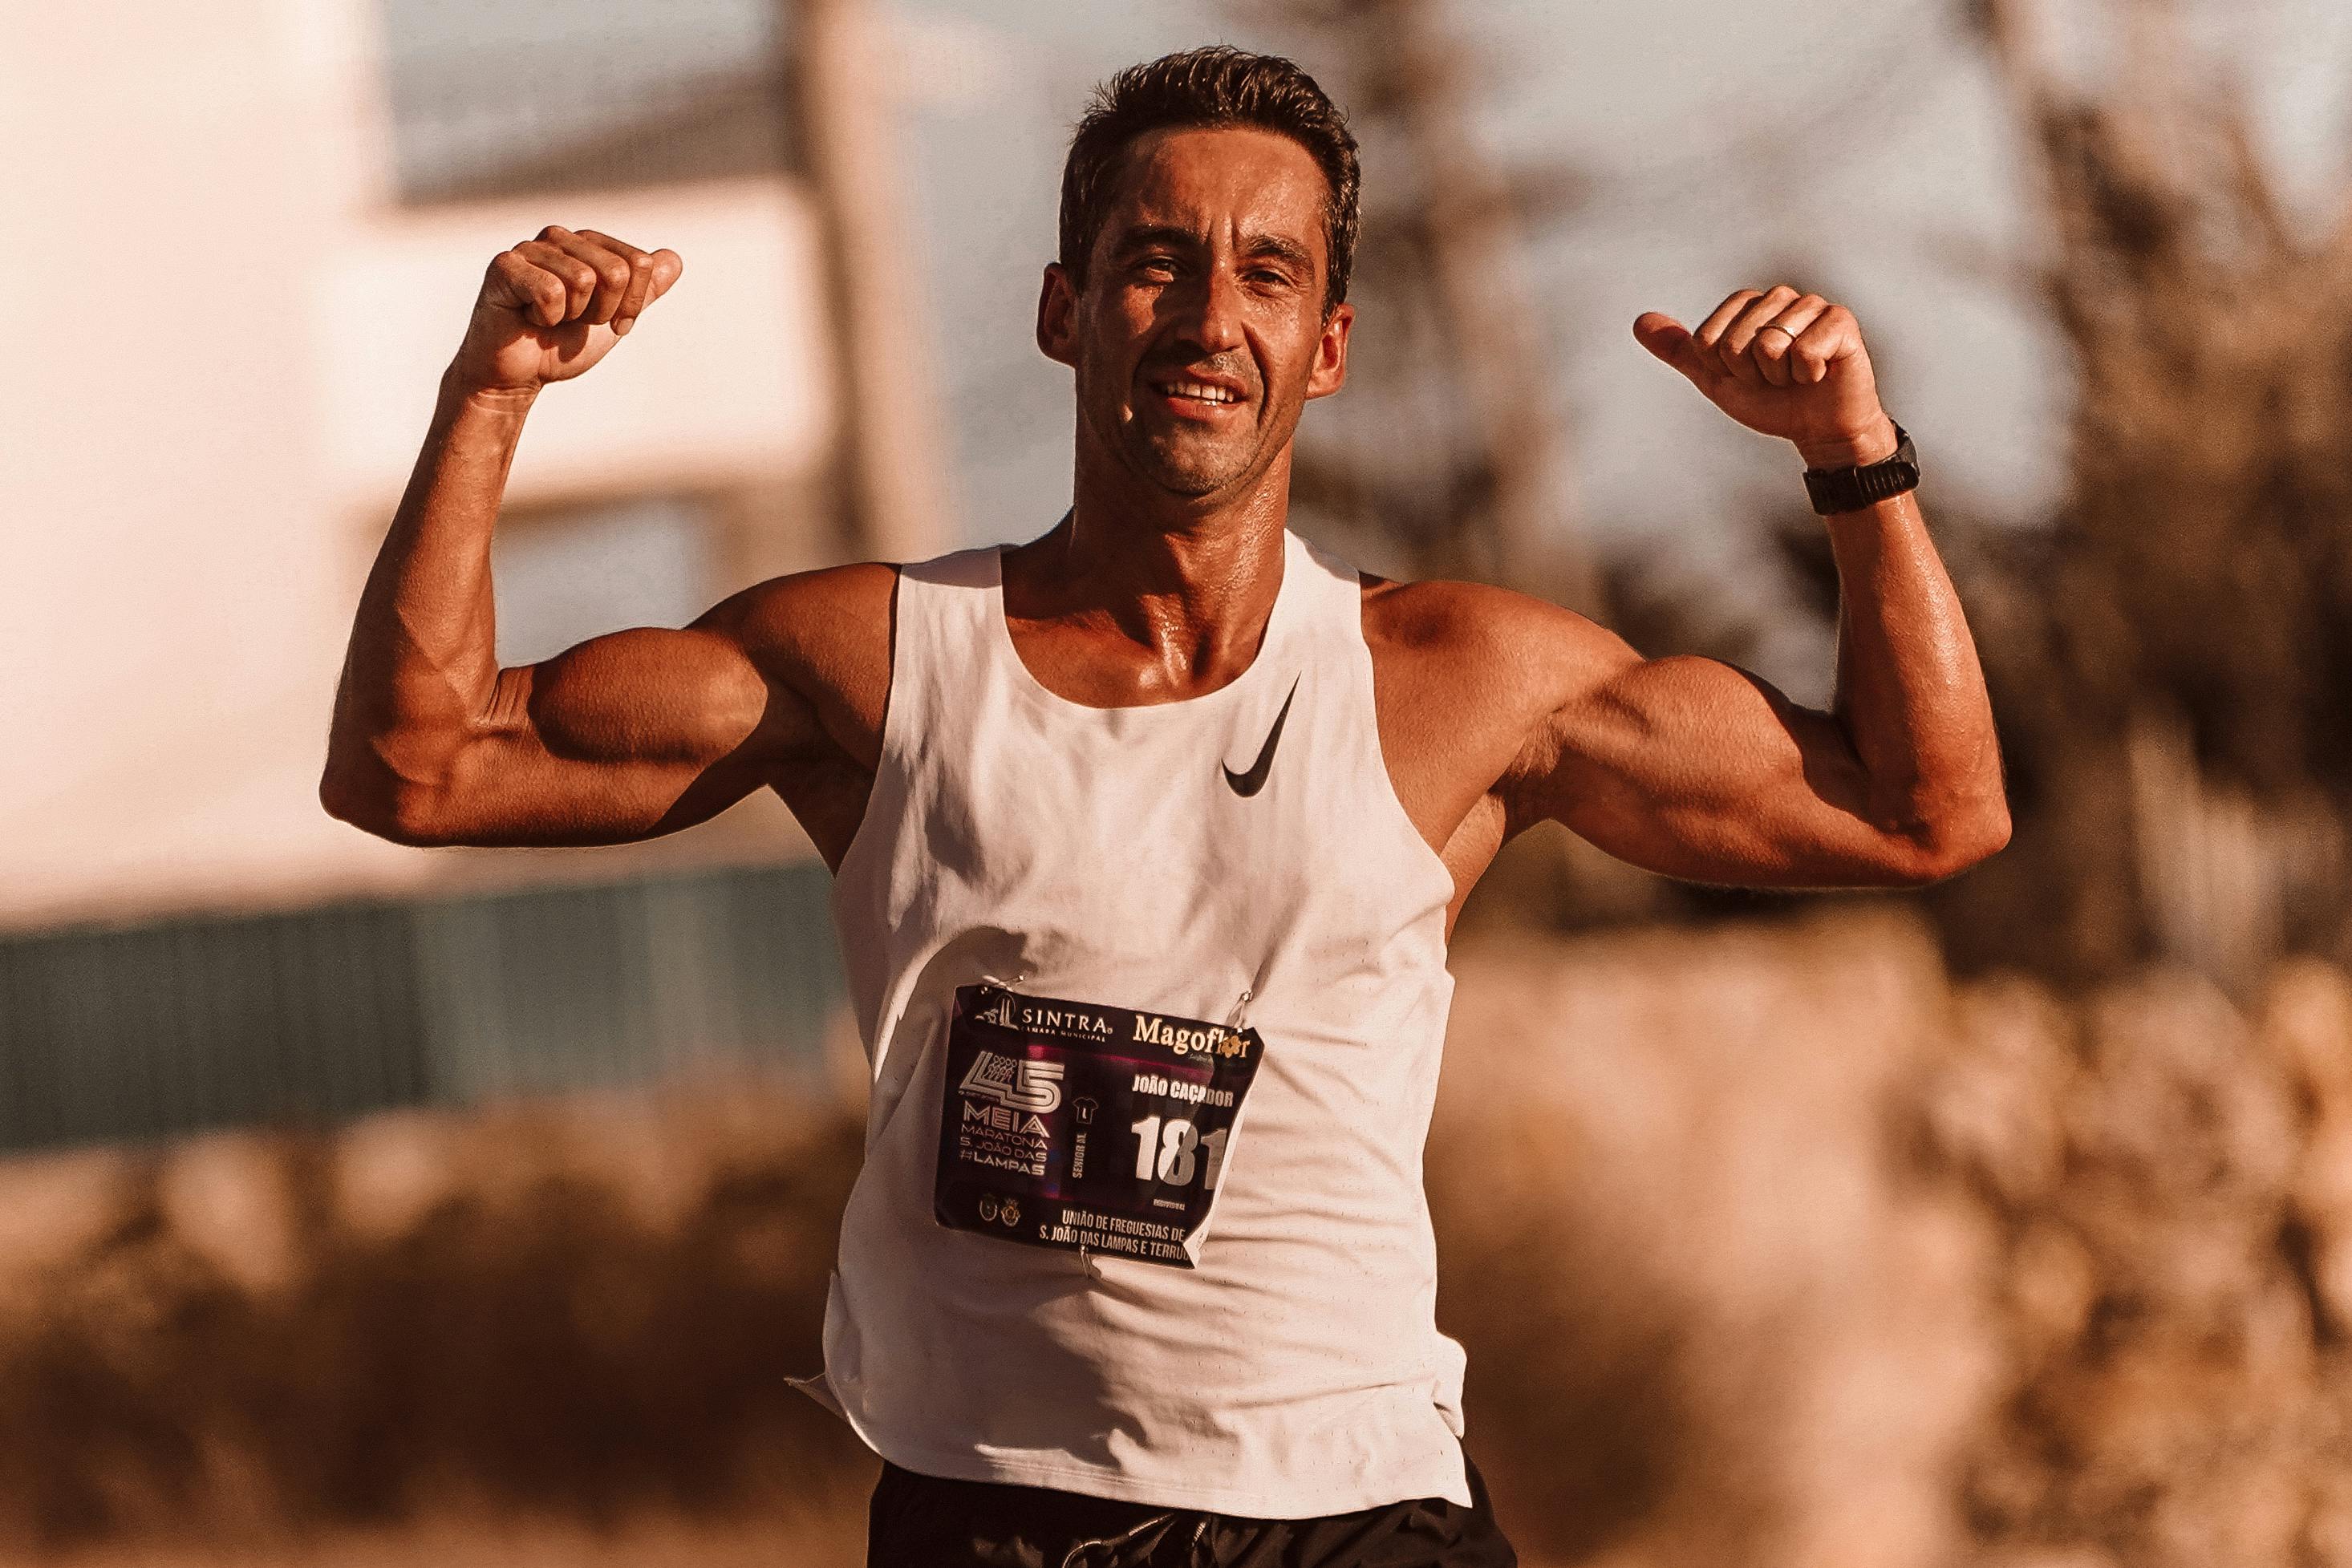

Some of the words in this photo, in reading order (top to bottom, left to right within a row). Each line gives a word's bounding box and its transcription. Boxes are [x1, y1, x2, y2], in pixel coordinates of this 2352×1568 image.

[1022, 1008, 1106, 1034] SINTRA
[1132, 1074, 1168, 1097] JOÃO
[1170, 1080, 1234, 1108] CAÇADOR
[963, 1100, 1051, 1139] MEIA
[959, 1136, 974, 1148] S.
[976, 1139, 1012, 1157] JOÃO
[1014, 1148, 1048, 1163] DAS
[960, 1123, 1048, 1150] MARATONA
[959, 1149, 1046, 1177] #LAMPAS
[1073, 1145, 1085, 1179] SENIOR
[1131, 1116, 1227, 1189] 181
[1039, 1224, 1049, 1240] S.
[1051, 1226, 1077, 1243] JOÃO
[1080, 1230, 1100, 1247] DAS
[1101, 1234, 1139, 1254] LAMPAS
[1141, 1240, 1147, 1254] E
[1062, 1209, 1094, 1228] UNIÃO
[1096, 1215, 1108, 1230] DE
[1110, 1218, 1169, 1242] FREGUESIAS
[1171, 1226, 1186, 1242] DE
